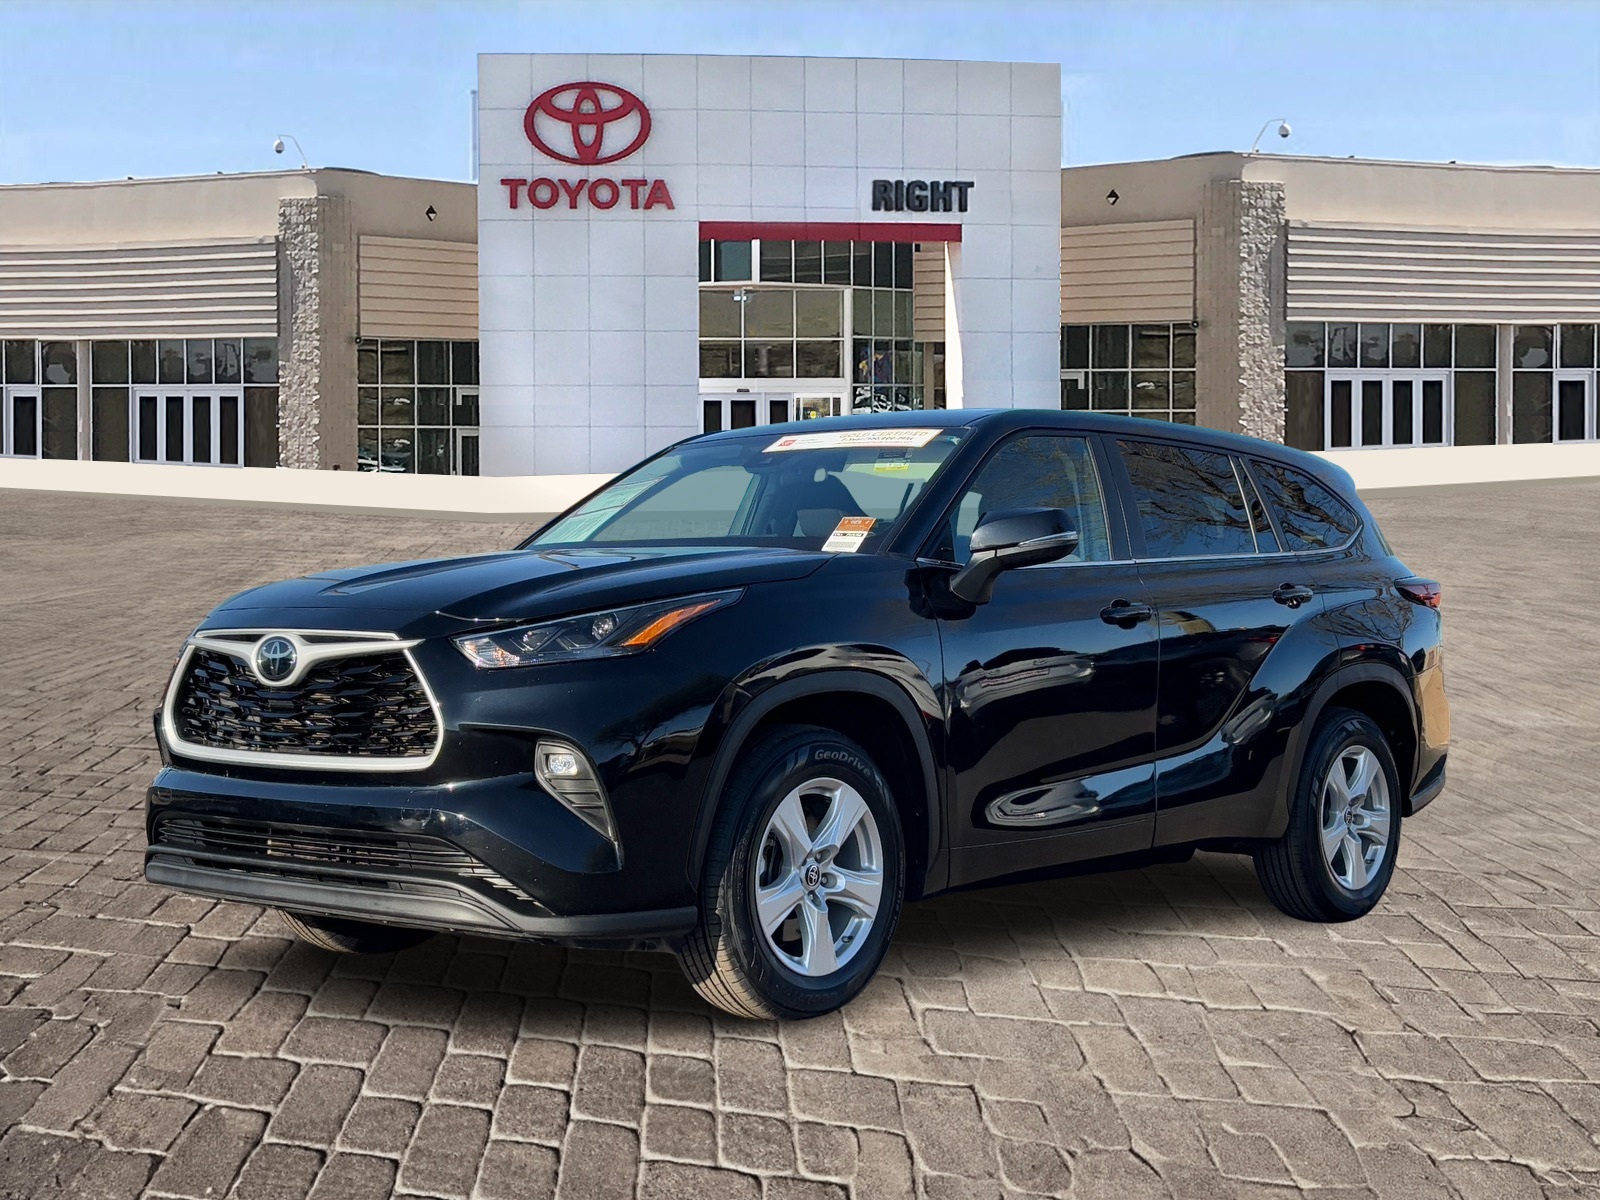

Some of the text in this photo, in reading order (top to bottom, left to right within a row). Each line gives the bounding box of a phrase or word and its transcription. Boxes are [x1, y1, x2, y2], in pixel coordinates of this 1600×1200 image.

[500, 178, 675, 209] TOYOTA
[872, 180, 974, 212] RIGHT
[814, 749, 871, 777] GeoDrive
